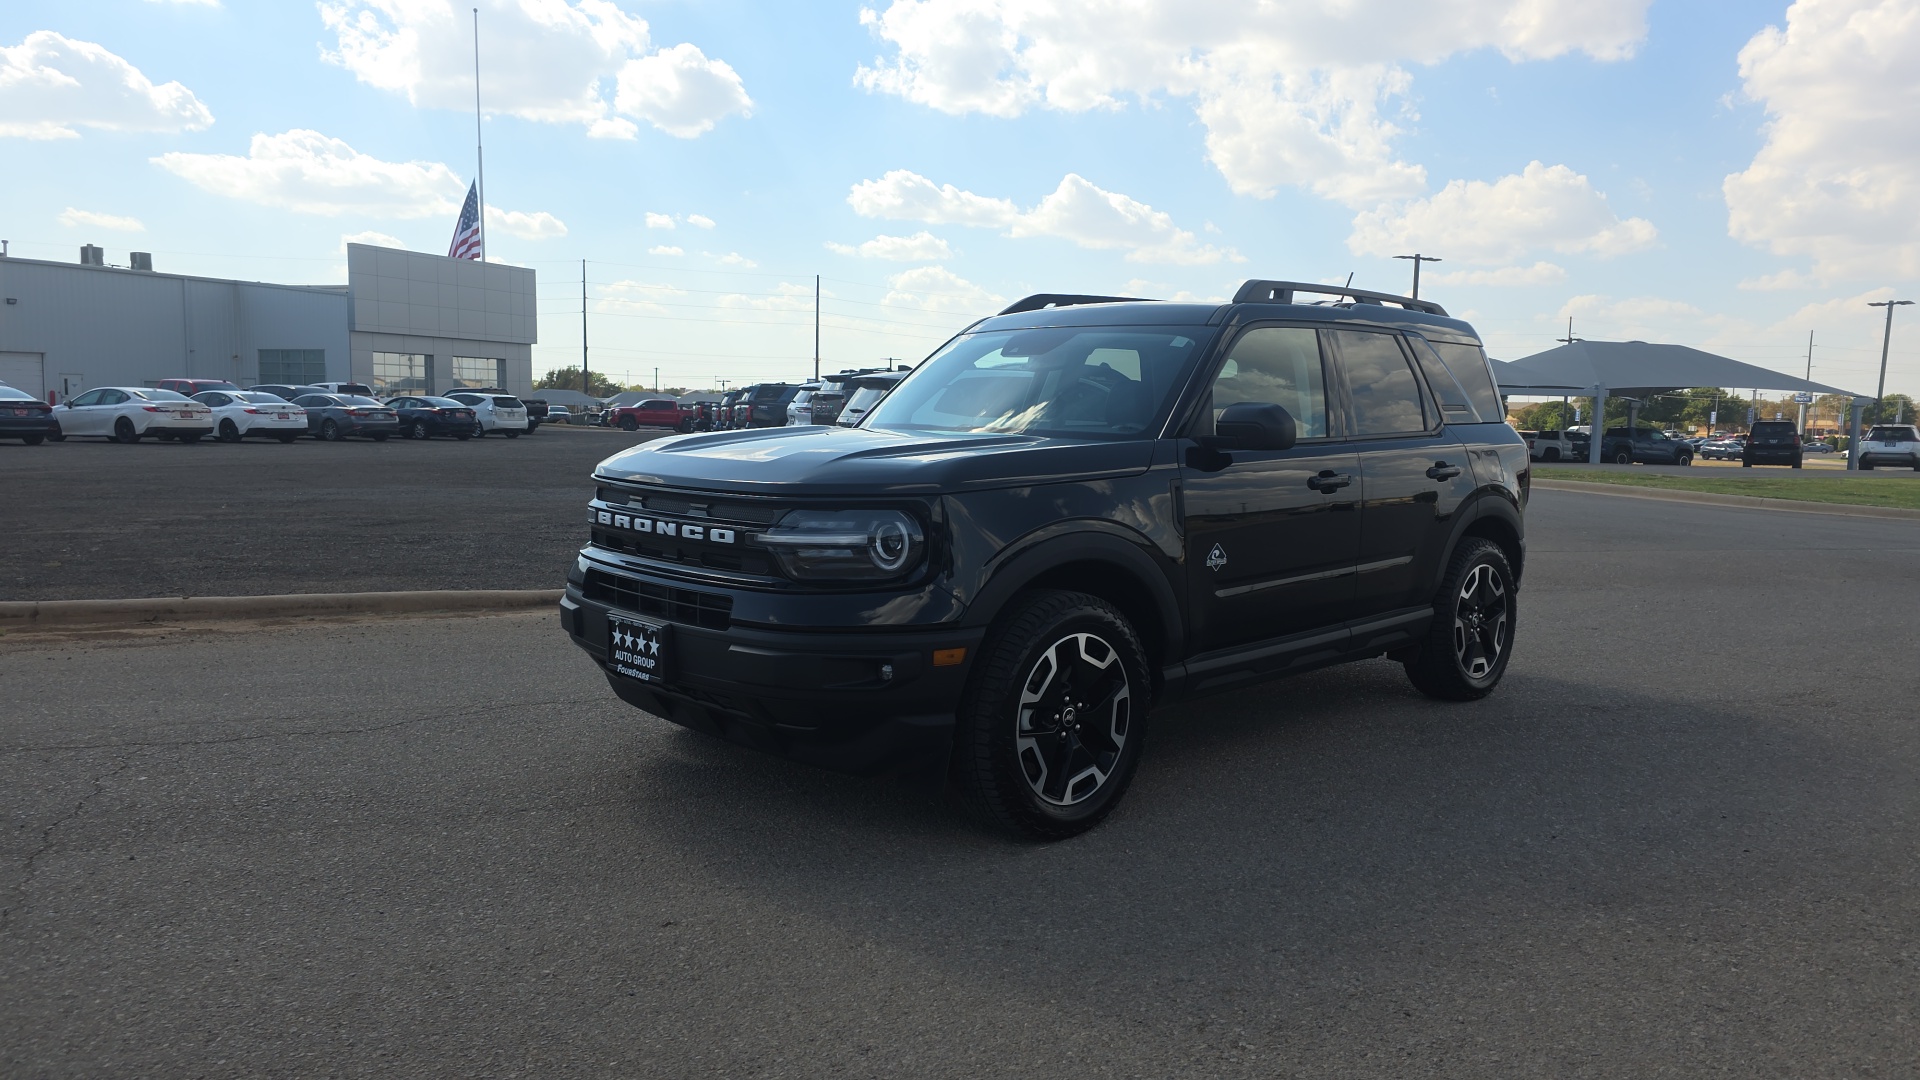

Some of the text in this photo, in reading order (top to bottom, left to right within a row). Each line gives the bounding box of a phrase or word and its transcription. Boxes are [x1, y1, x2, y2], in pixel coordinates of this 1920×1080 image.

[597, 510, 735, 544] BRONCO
[614, 649, 656, 669] AUTO GROUP
